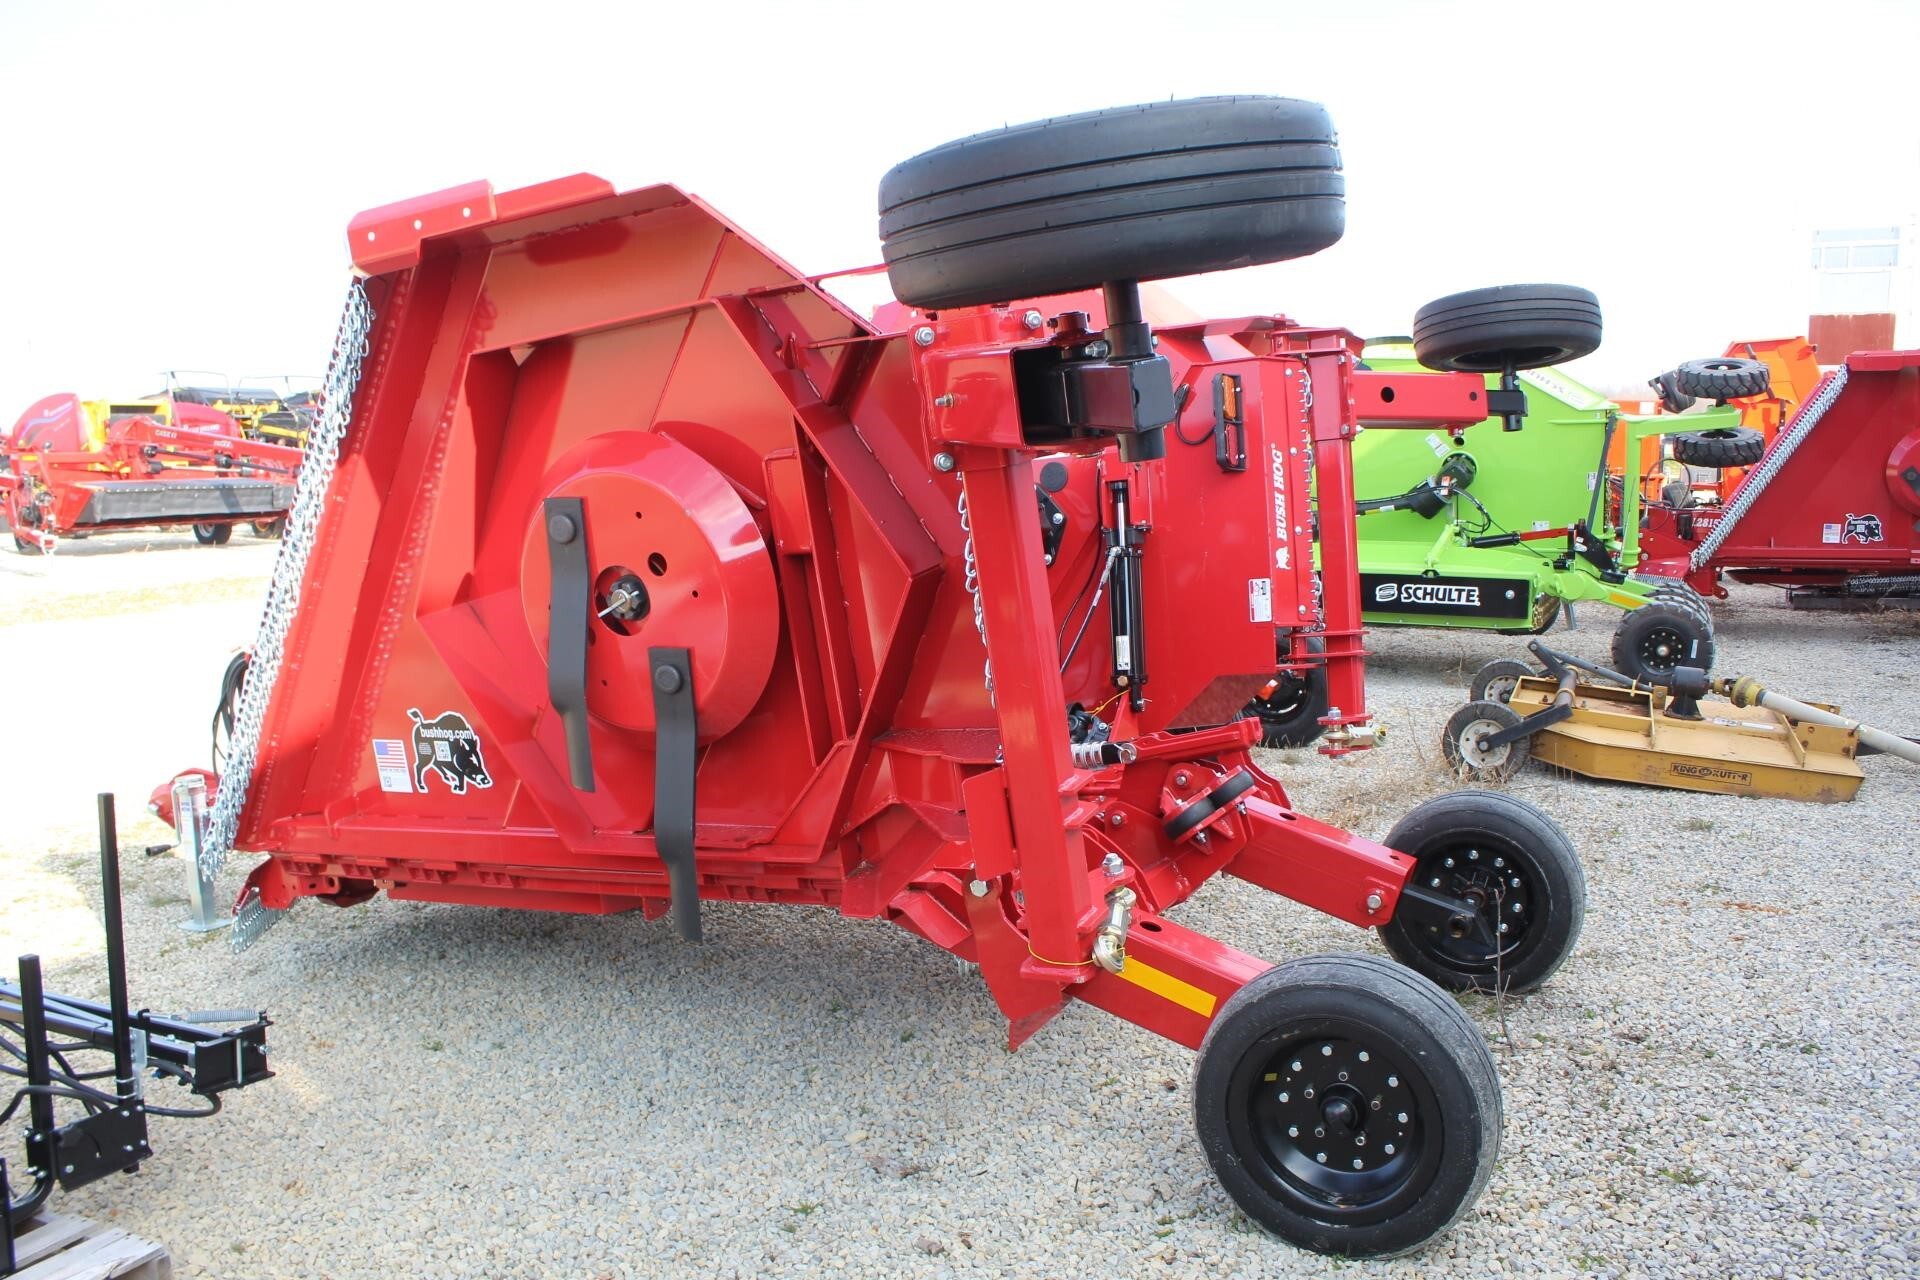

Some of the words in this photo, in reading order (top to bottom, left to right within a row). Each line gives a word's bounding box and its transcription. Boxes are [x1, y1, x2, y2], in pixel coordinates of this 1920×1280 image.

[1272, 449, 1285, 491] HOG
[1275, 491, 1288, 542] BUSH
[1401, 584, 1479, 606] SCHULTE
[420, 727, 472, 741] bushhog.com
[1672, 764, 1697, 774] KING
